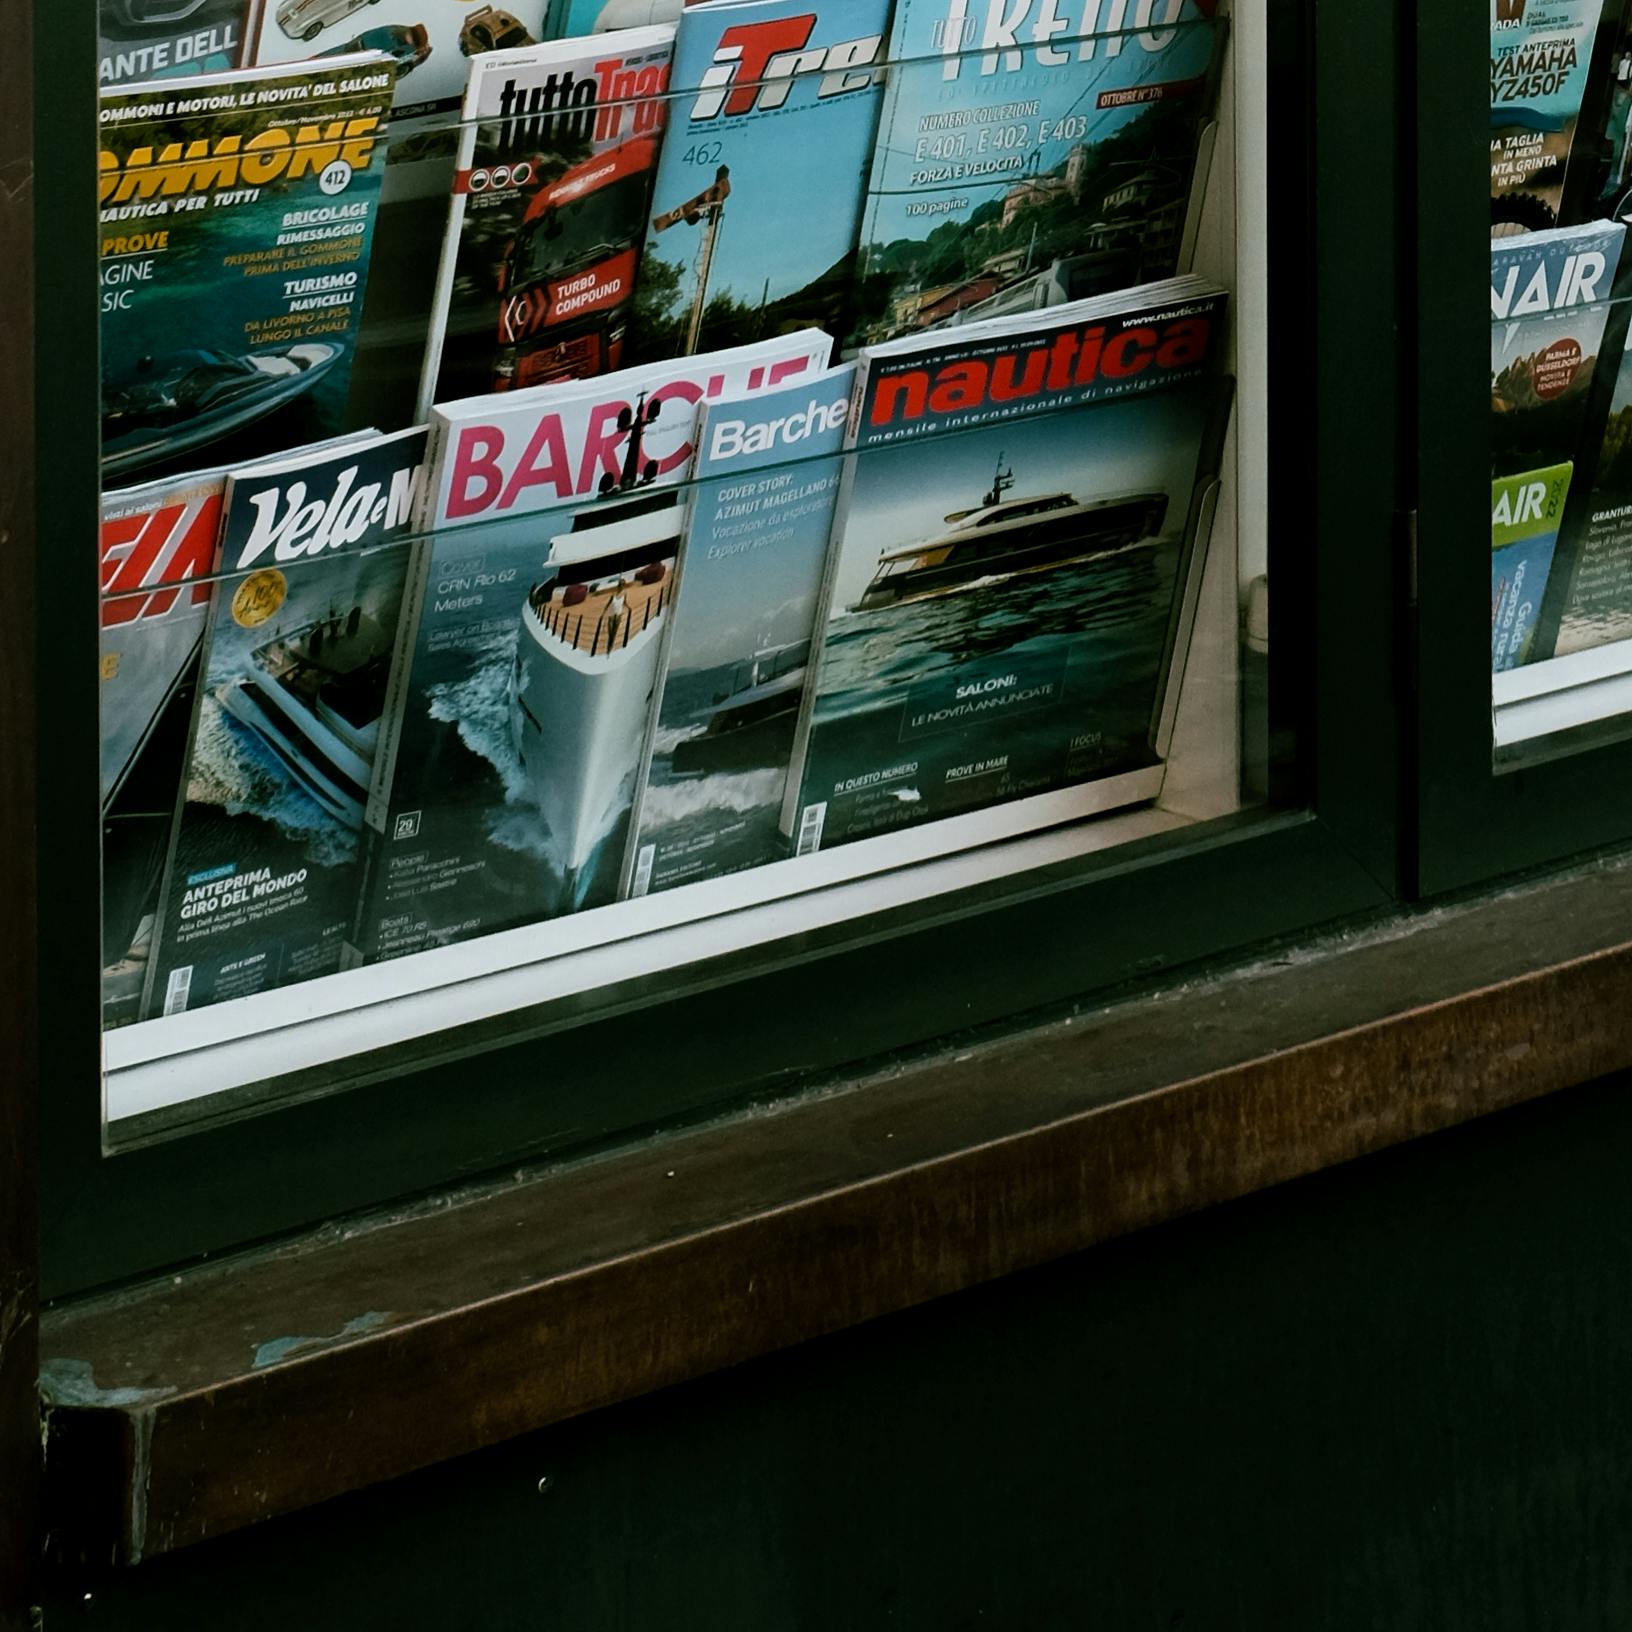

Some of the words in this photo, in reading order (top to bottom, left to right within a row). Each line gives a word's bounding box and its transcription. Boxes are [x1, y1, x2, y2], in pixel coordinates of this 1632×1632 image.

[1519, 37, 1577, 55] ANTEPRIMA
[1489, 47, 1578, 81] YAMAHA
[176, 95, 238, 116] MOTORI,
[339, 73, 390, 94] SALONE
[1489, 72, 1570, 104] YZ450F
[918, 111, 971, 133] NUMERO
[971, 99, 1041, 127] COLLEZIONE
[1051, 115, 1089, 142] 403
[681, 141, 724, 166] 462
[1504, 132, 1546, 152] TAGLIA
[1515, 153, 1558, 172] GRINTA
[909, 167, 954, 186] FORZA
[212, 188, 261, 209] TUTTI
[926, 195, 970, 219] pagine
[281, 201, 370, 228] BRICOLAGE
[101, 231, 170, 258] PROVE
[275, 222, 367, 247] RIMESSAGGIO
[283, 271, 359, 296] TURISMO
[555, 278, 623, 316] COMPOUND
[556, 273, 597, 301] TURBO
[288, 292, 355, 314] NAVICELLI
[1121, 301, 1216, 329] www.nautica.it
[869, 312, 1214, 426] nautica
[706, 397, 848, 464] Barche
[866, 421, 938, 445] mensile
[943, 392, 1073, 429] internazionale
[716, 482, 757, 504] COVER
[234, 464, 383, 570] Vela
[713, 497, 762, 522] AZIMUT
[954, 672, 1020, 702] SALONI:
[973, 680, 1056, 715] ANNUNCIATE
[179, 893, 221, 920] GIRO
[219, 887, 251, 911] DEL
[251, 867, 310, 900] MONDO
[180, 866, 272, 905] ANTEPRIMA
